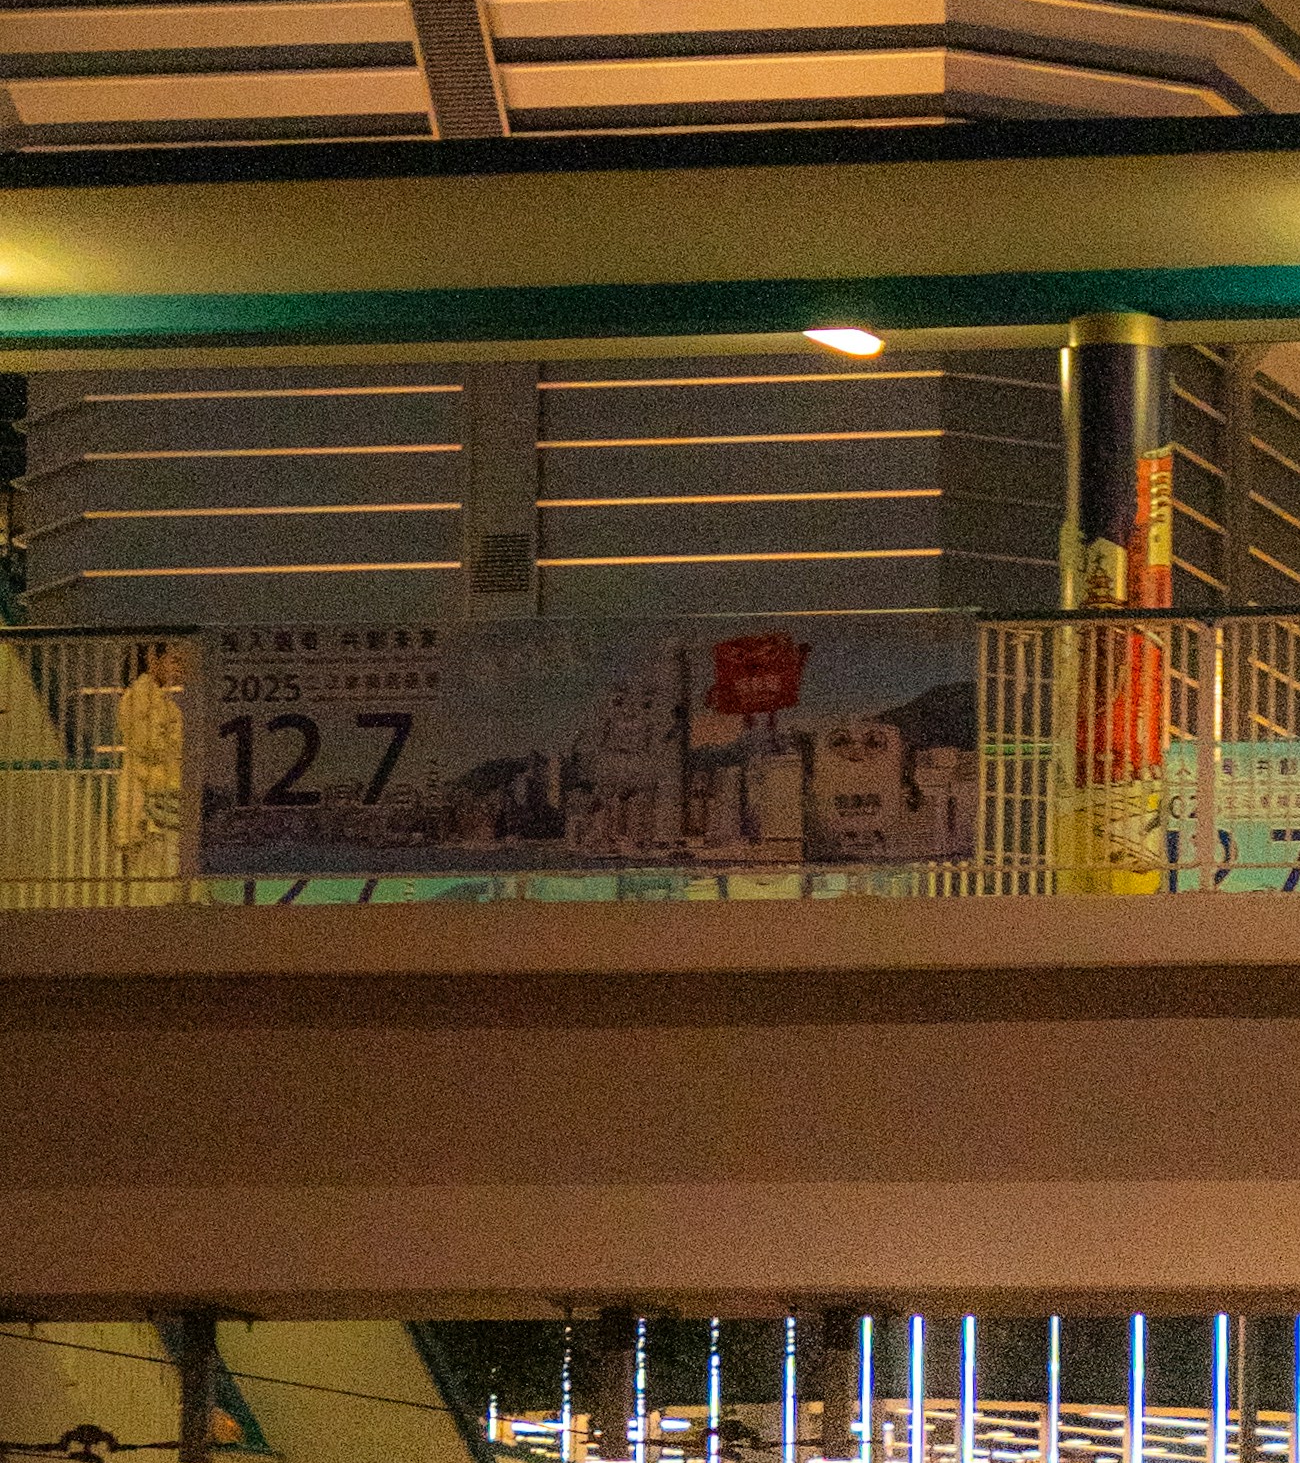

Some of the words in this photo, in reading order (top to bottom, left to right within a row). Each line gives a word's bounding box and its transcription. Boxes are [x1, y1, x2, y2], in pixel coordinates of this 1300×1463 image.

[222, 674, 301, 702] 2025
[220, 713, 321, 806] 12
[357, 713, 412, 804] 7
